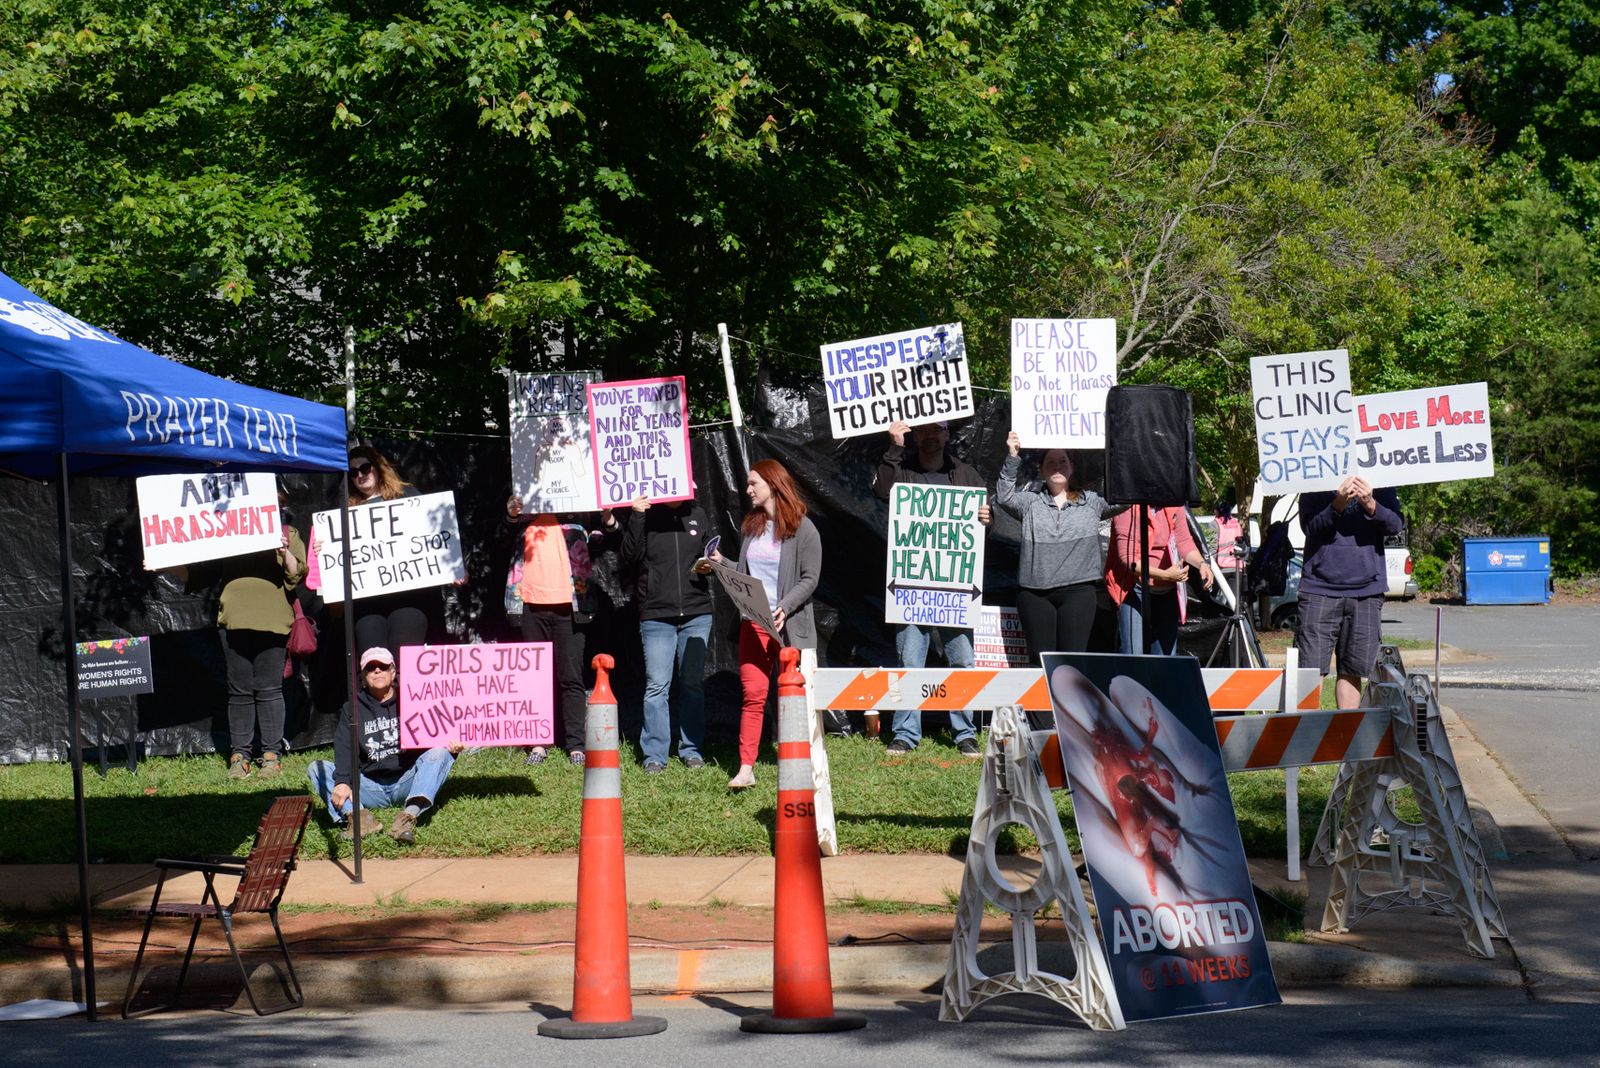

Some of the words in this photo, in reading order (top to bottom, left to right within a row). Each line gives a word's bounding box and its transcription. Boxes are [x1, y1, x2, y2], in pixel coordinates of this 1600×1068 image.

[1015, 321, 1089, 350] PLEASE
[1023, 352, 1045, 372] BE
[1056, 351, 1098, 372] KIND
[1266, 359, 1336, 387] THIS
[826, 371, 886, 404] YOUR
[891, 357, 963, 394] RIGHT
[1014, 376, 1030, 391] Do
[1038, 375, 1062, 391] Not
[528, 395, 584, 413] RIGHTS
[592, 388, 635, 406] YOU'VE
[638, 384, 678, 404] PRAYED
[1034, 393, 1079, 412] CLINIC
[1256, 390, 1352, 420] CLINIC
[621, 405, 644, 418] FOR
[834, 404, 866, 430] TO
[871, 386, 969, 425] CHOOSE
[1357, 404, 1420, 433] LOVE
[1427, 394, 1486, 427] MORE
[120, 390, 234, 449] PRAYER
[235, 402, 299, 457] TENT
[596, 416, 640, 434] NINE
[644, 412, 682, 430] YEARS
[1034, 412, 1107, 436] PATIENT
[604, 434, 632, 448] AND
[637, 430, 668, 445] THIS
[1261, 425, 1350, 456] STAYS
[1356, 436, 1431, 468] JUDGE
[1434, 431, 1488, 463] LESS
[549, 456, 564, 464] BODY
[611, 445, 655, 462] CLINIC
[658, 442, 672, 458] IS
[602, 460, 668, 485] STILL
[1260, 452, 1349, 484] OPEN!
[180, 472, 249, 507] ANTI
[546, 486, 569, 494] CHOICE
[551, 480, 562, 488] MY
[610, 478, 677, 502] OPEN!
[896, 485, 987, 520] PROTECT
[143, 504, 277, 548] HARASSMENT
[894, 520, 975, 550] WOMEN'S
[411, 530, 451, 554] STOP
[378, 555, 441, 587] BIRTH
[892, 550, 976, 584] HEALTH
[896, 590, 968, 608] PRO-CHOICE
[904, 606, 968, 626] CHARLOTTE
[114, 668, 142, 677] RIGHTS
[417, 648, 482, 675] GIRLS
[493, 647, 546, 672] JUST
[90, 680, 118, 689] HUMAN
[120, 676, 148, 686] RIGHTS
[407, 679, 464, 701] WANNA
[477, 674, 518, 696] HAVE
[922, 684, 946, 698] SWS
[460, 722, 500, 742] HUMAN
[504, 719, 550, 740] RIGHTS
[1113, 898, 1254, 954] ABORTED
[1140, 968, 1156, 991] @
[1160, 961, 1185, 986] 11
[1186, 955, 1252, 984] WEEKS
